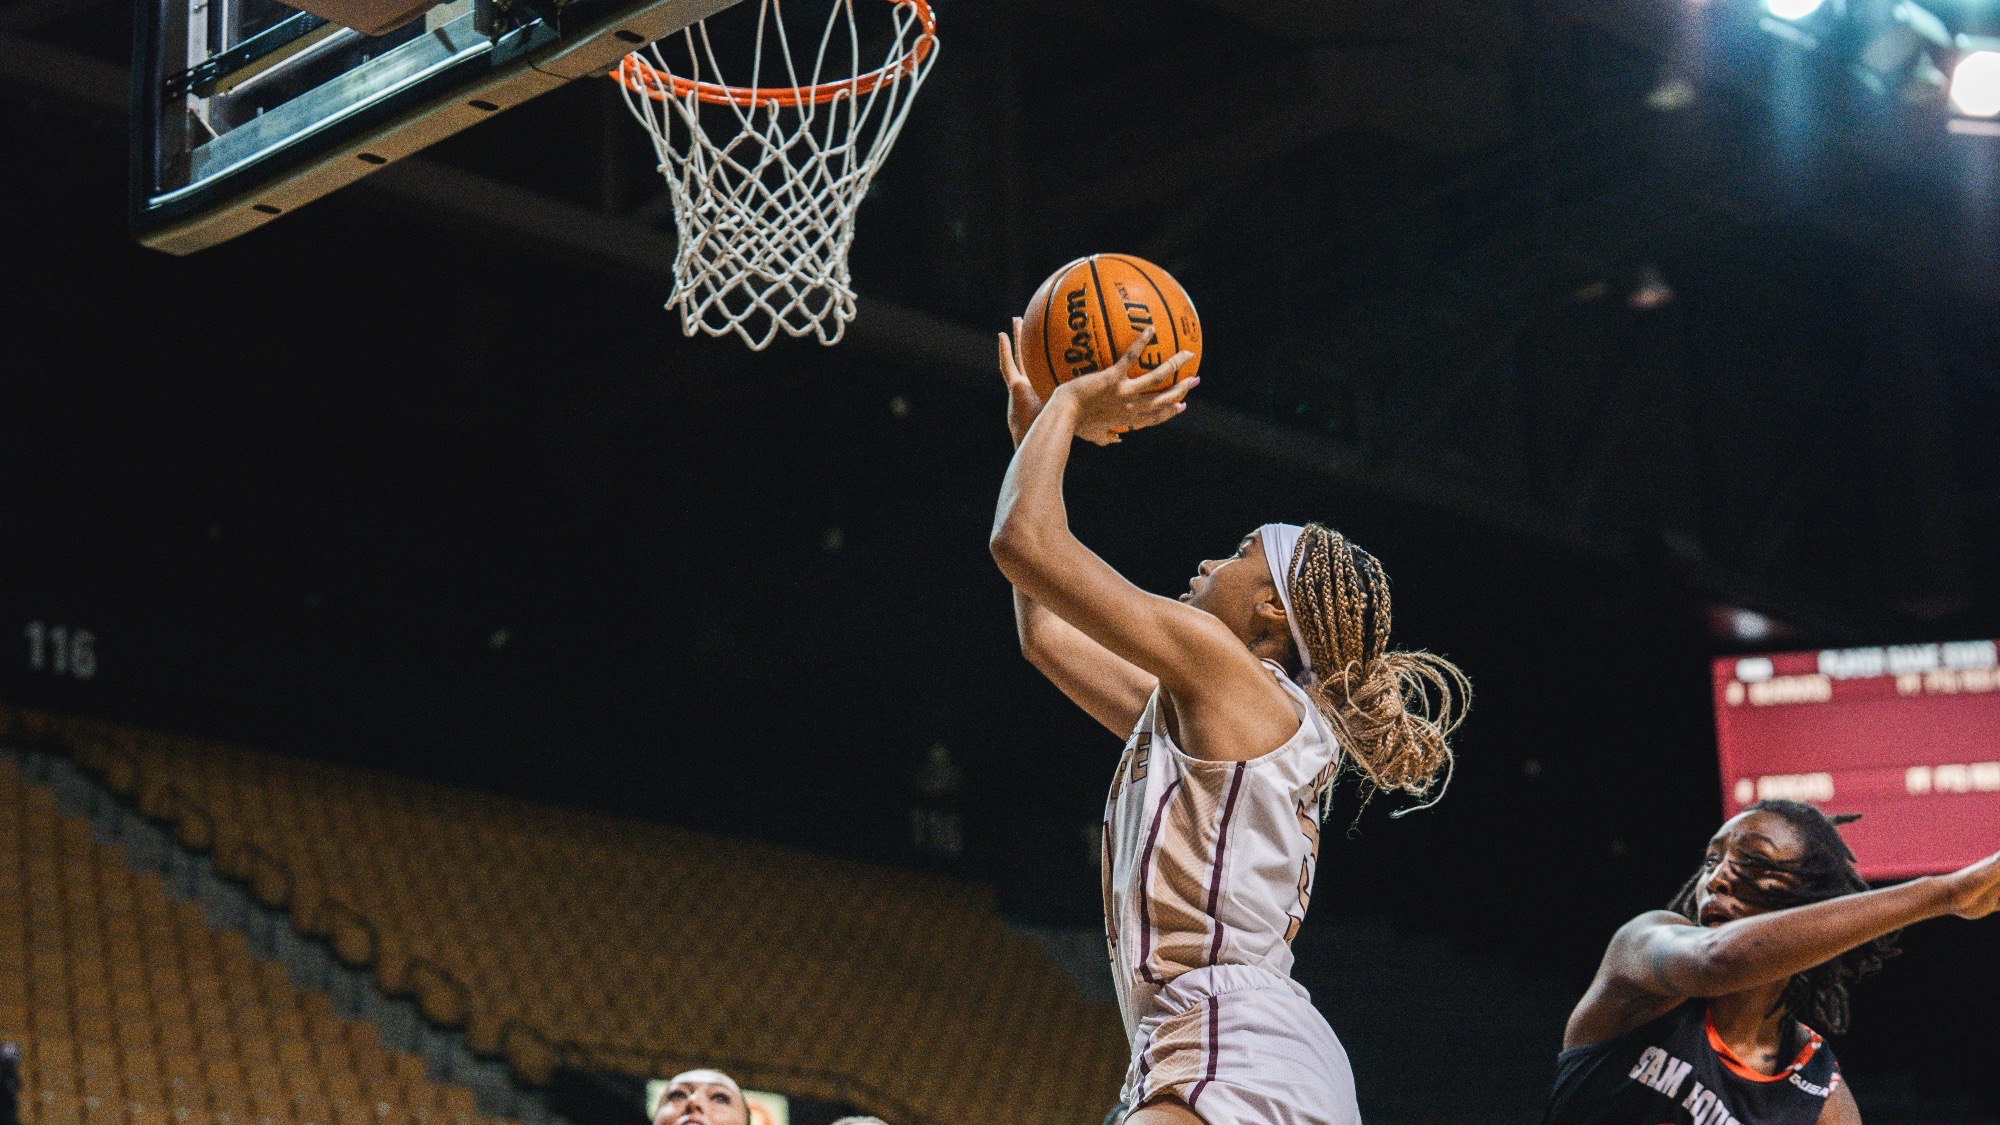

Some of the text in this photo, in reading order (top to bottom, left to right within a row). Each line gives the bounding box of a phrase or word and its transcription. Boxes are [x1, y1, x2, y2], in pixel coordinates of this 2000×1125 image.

[1063, 285, 1099, 378] ilson
[23, 621, 97, 680] 116
[1629, 1045, 1693, 1099] SAM
